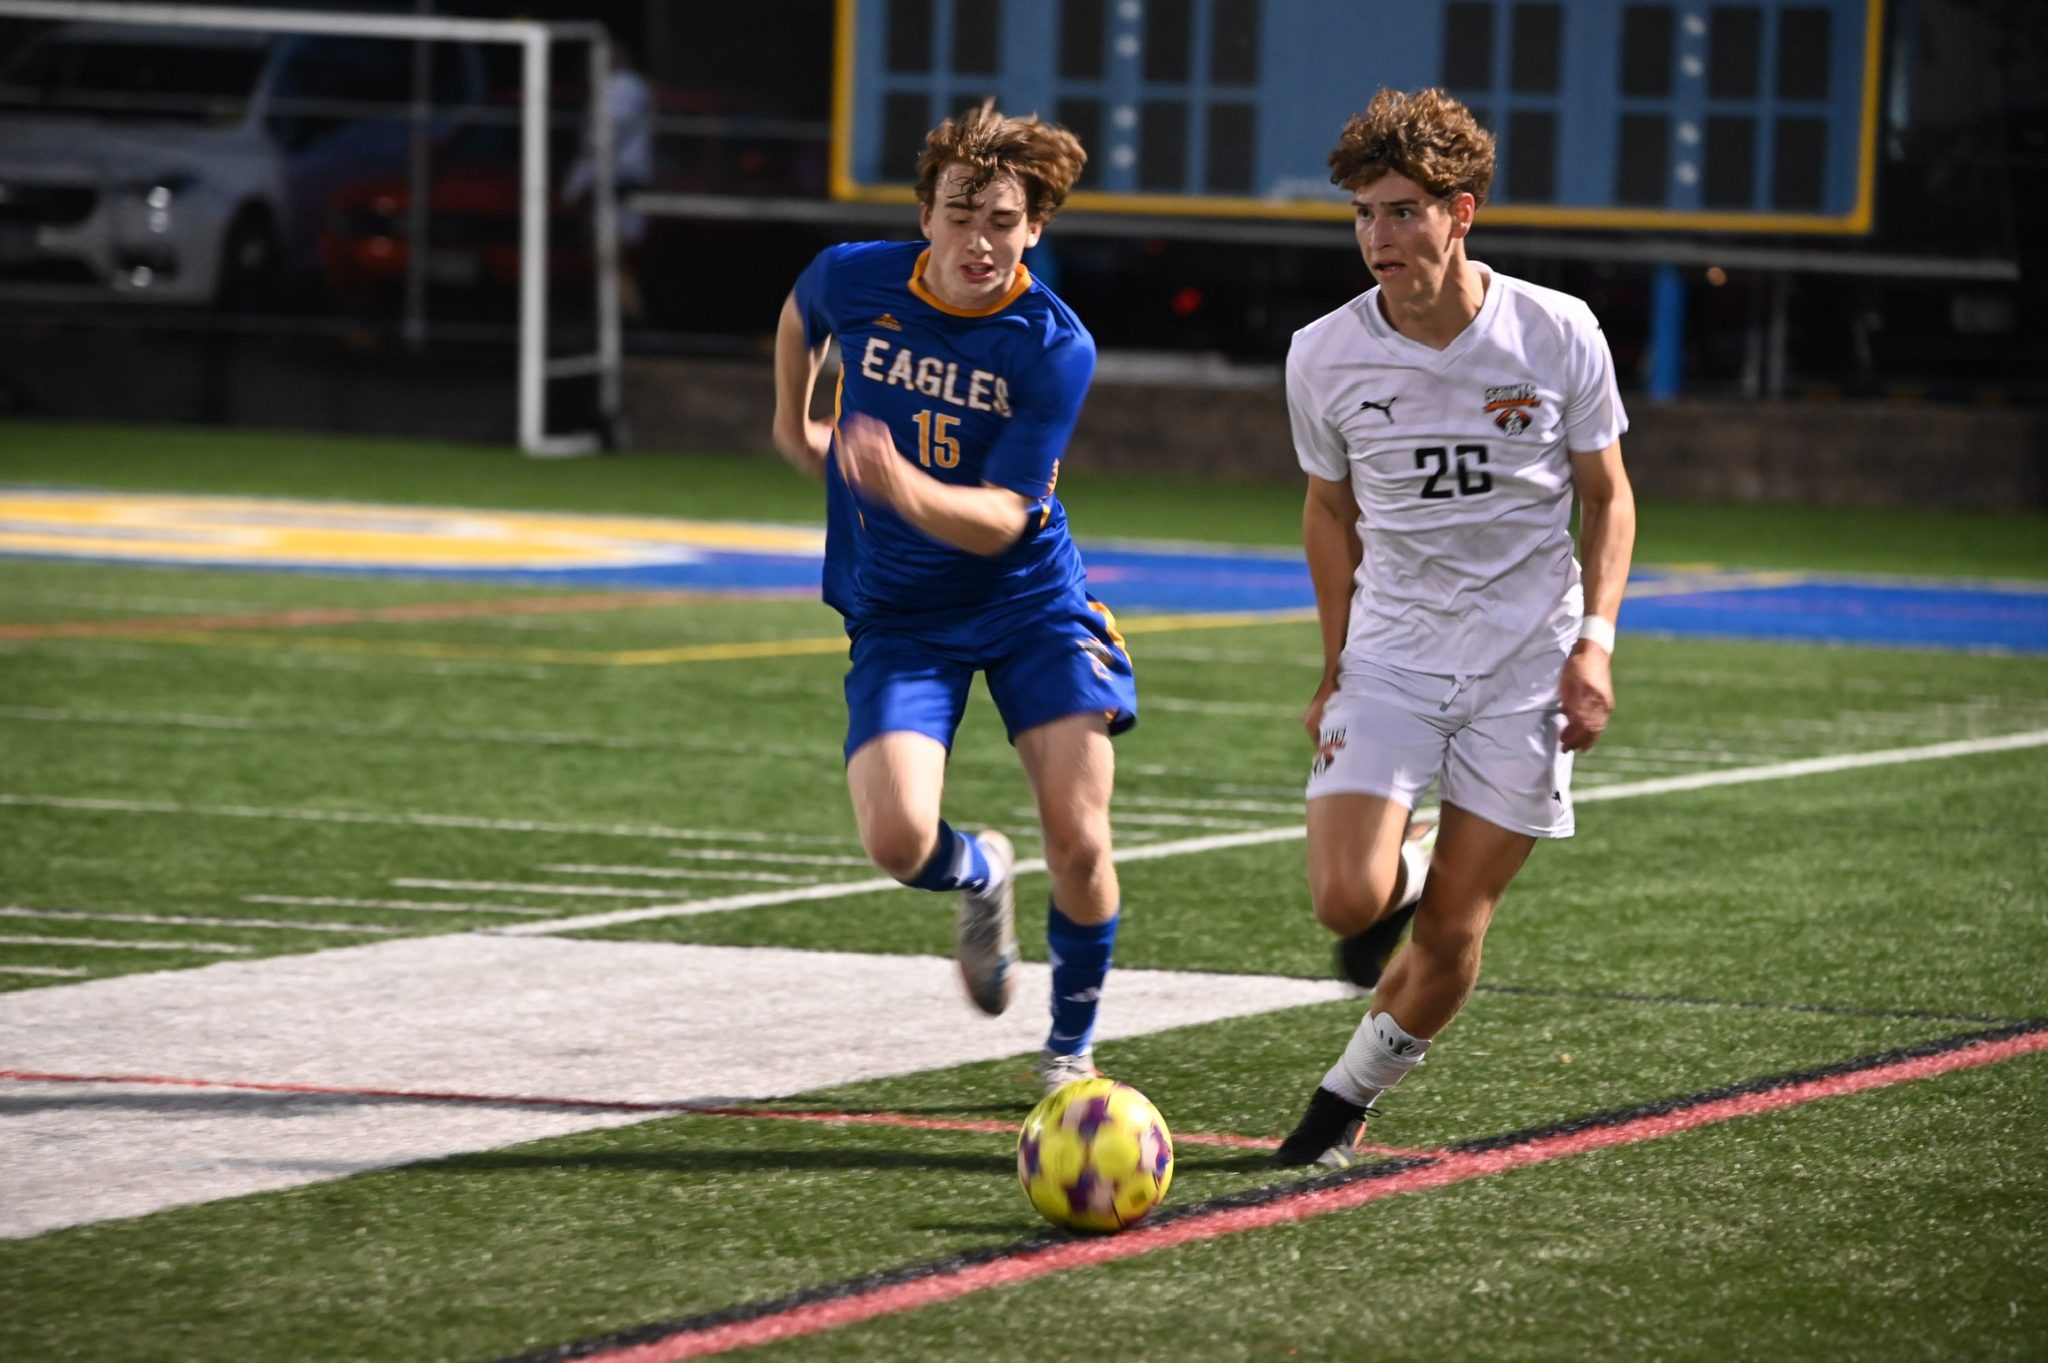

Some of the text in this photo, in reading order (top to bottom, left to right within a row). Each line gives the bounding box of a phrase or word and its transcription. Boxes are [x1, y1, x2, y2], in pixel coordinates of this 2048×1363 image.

[861, 336, 1012, 418] EAGLES
[912, 409, 961, 469] 15
[1415, 444, 1493, 499] 26
